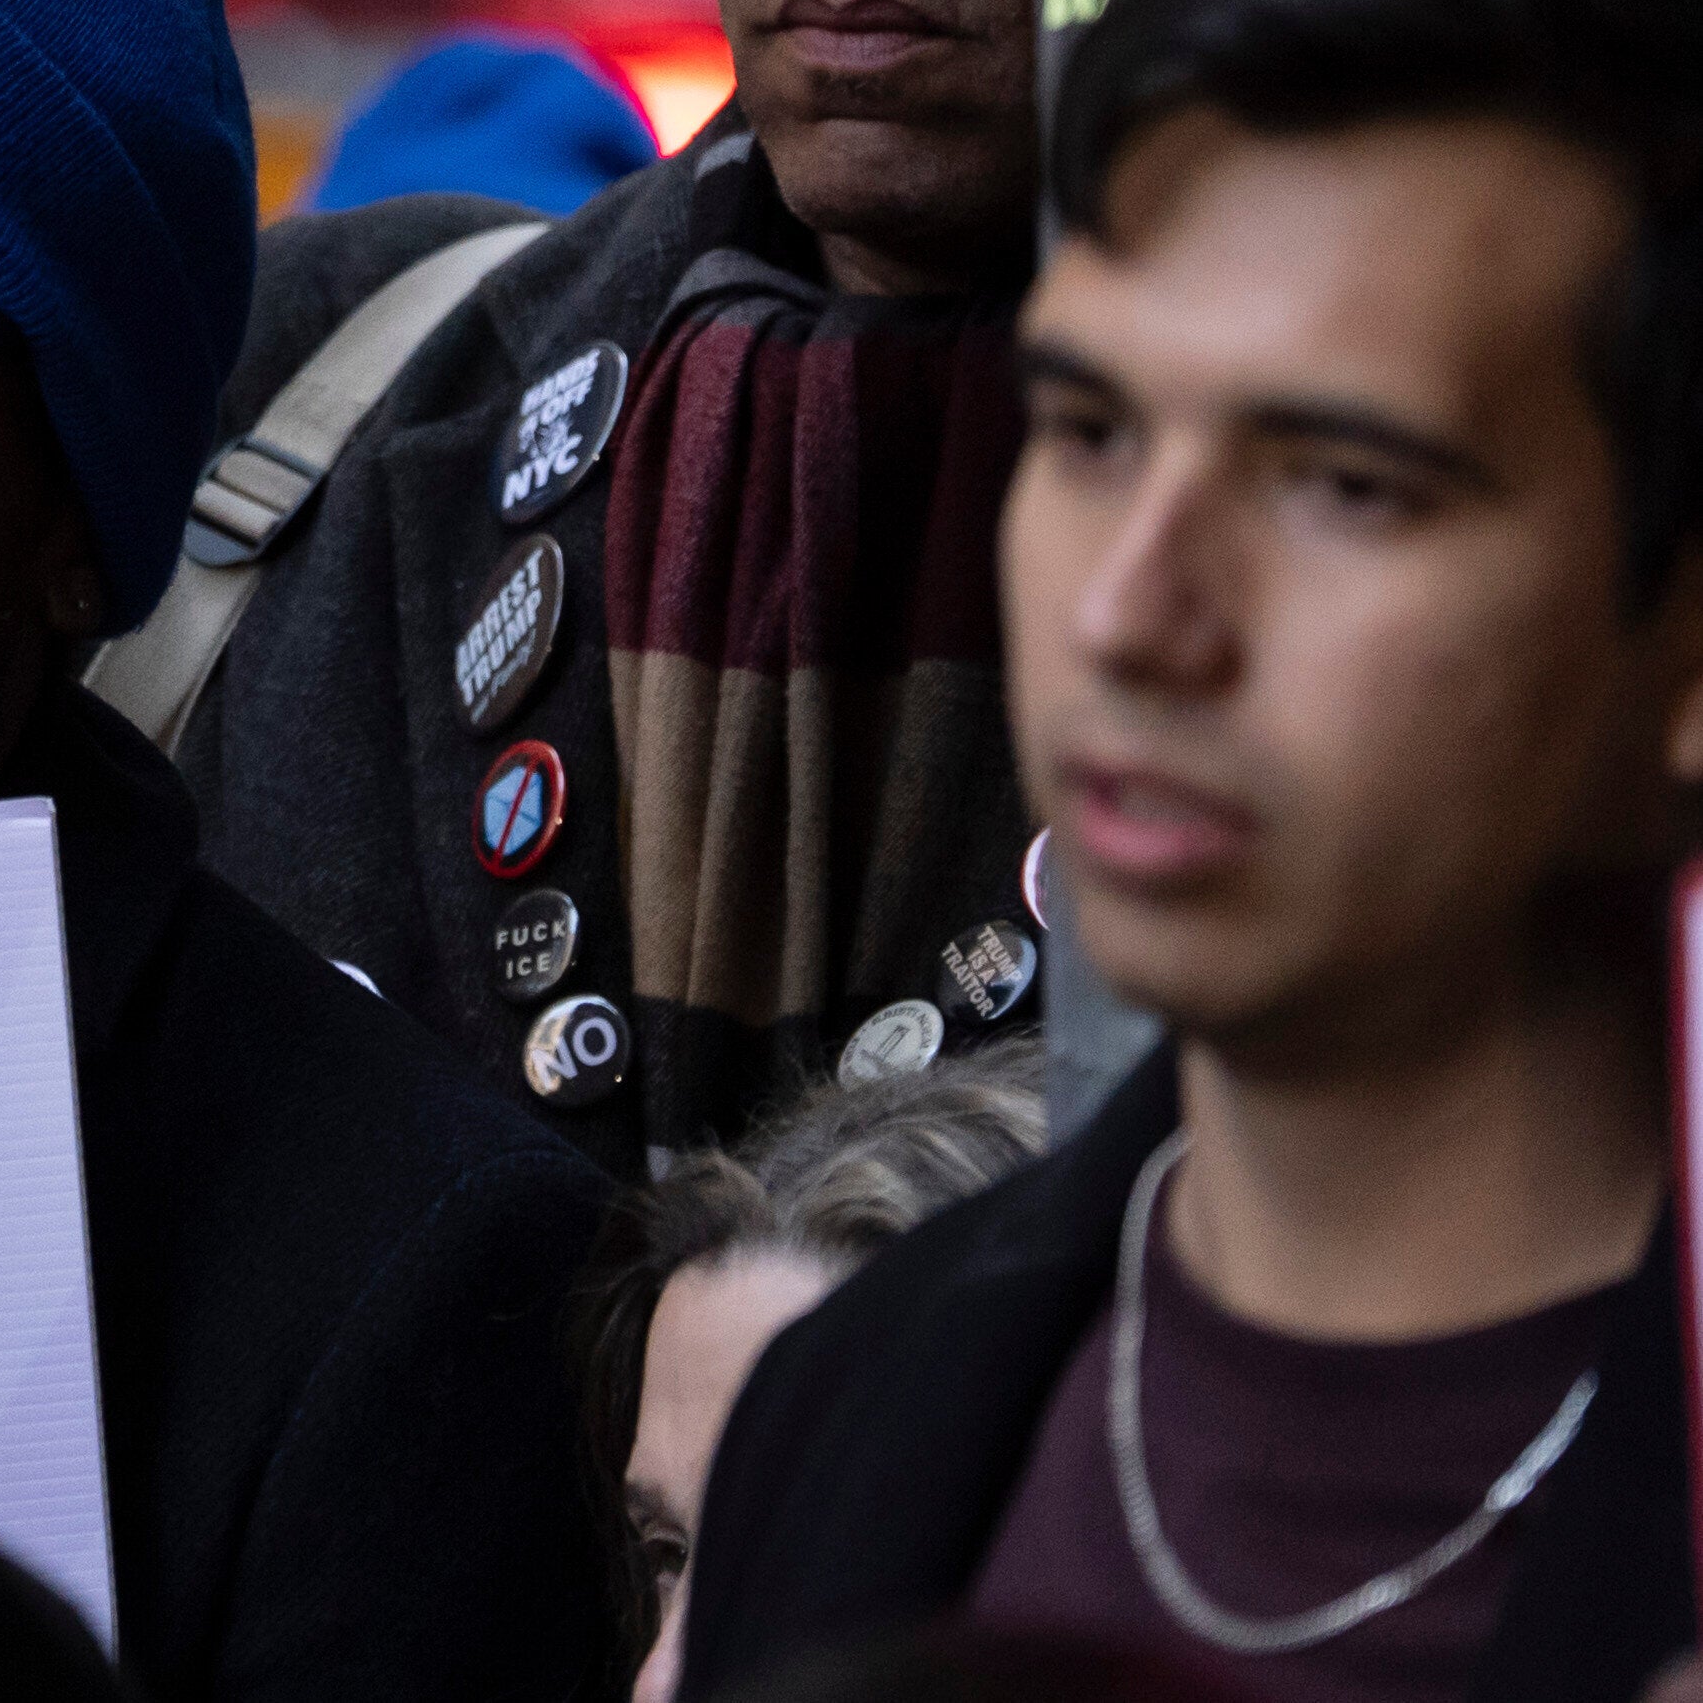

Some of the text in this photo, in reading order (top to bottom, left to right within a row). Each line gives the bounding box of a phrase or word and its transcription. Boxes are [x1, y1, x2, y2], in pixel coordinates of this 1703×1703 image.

[501, 434, 583, 510] NYC
[455, 547, 545, 685] ARREST
[462, 588, 543, 706] TRUMP
[496, 919, 567, 950] FUCK
[505, 951, 552, 980] ICE
[967, 947, 997, 987] IS A
[977, 924, 1024, 982] TRUMP
[941, 940, 995, 1017] TRAITOR
[531, 1016, 618, 1093] NO
